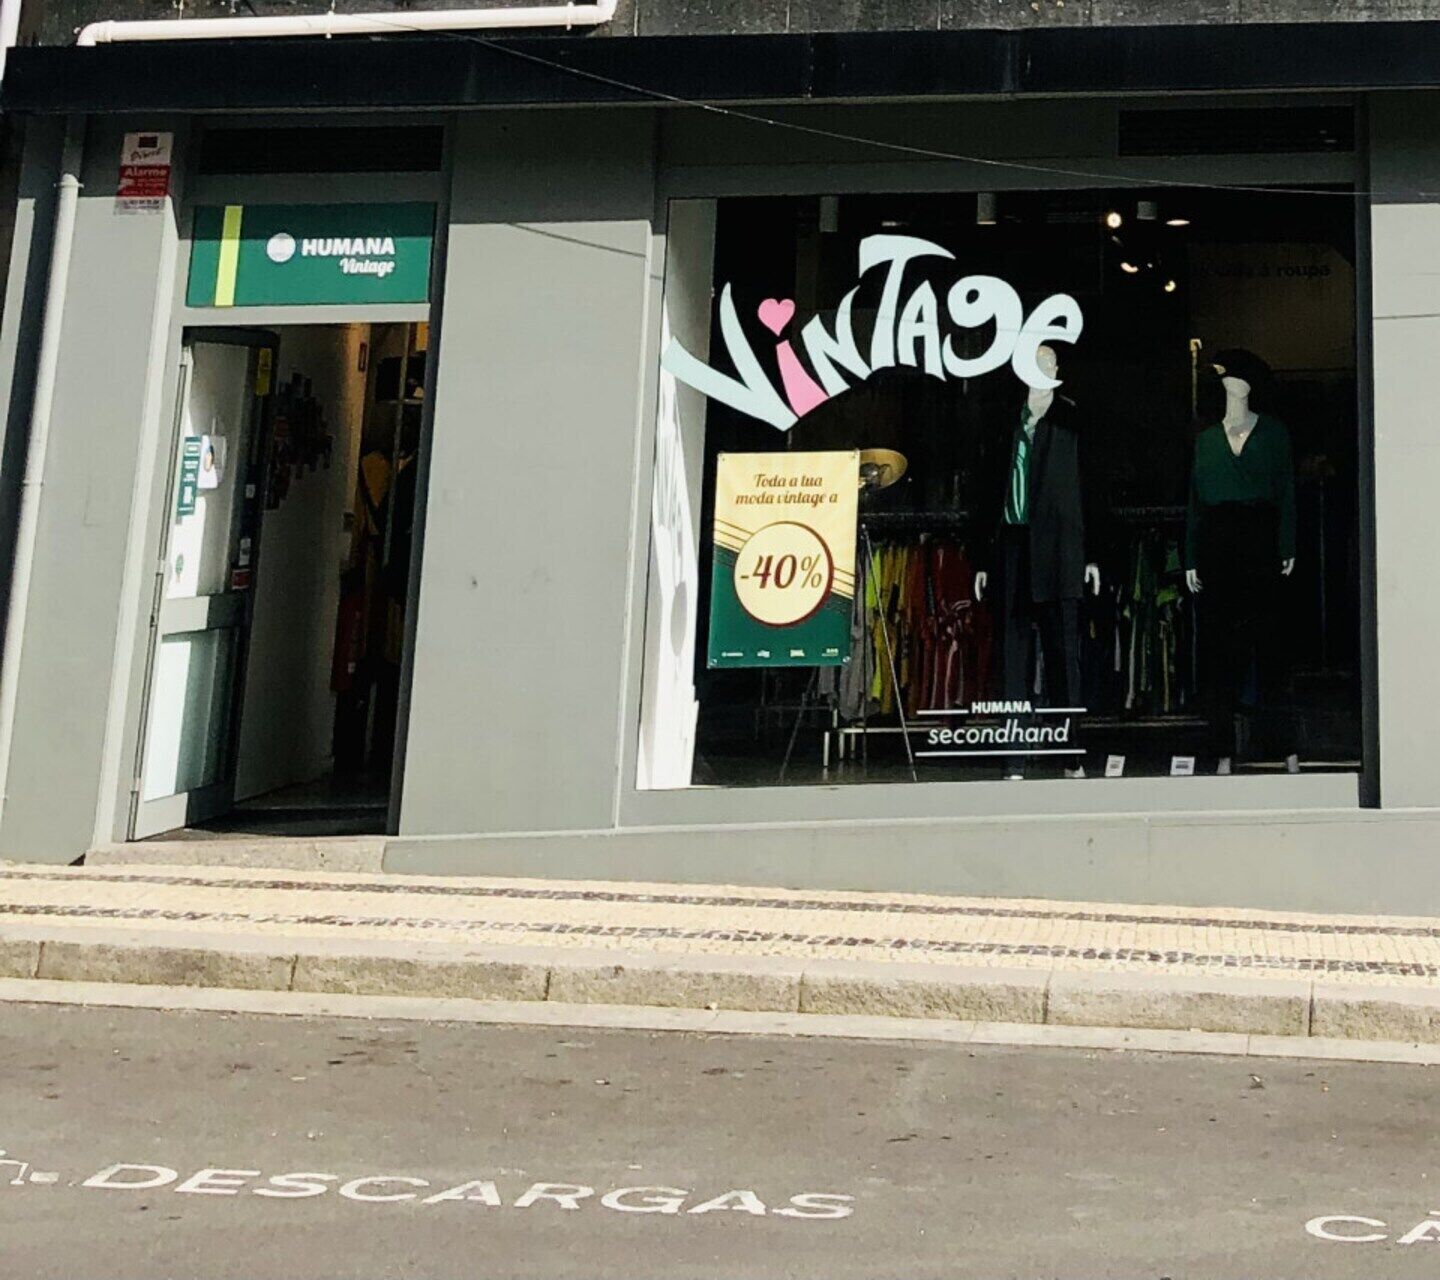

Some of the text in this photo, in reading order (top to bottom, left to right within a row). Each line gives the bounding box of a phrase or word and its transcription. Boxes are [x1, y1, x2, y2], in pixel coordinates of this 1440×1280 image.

[301, 237, 396, 256] HUMANA
[339, 258, 396, 278] Vintage
[753, 473, 823, 488] Toda a tua
[735, 490, 838, 508] moda vintage a
[740, 553, 823, 590] -40%
[971, 701, 1032, 714] HUMANA
[928, 717, 1071, 745] secondhand
[82, 1163, 856, 1219] DESCARGAS
